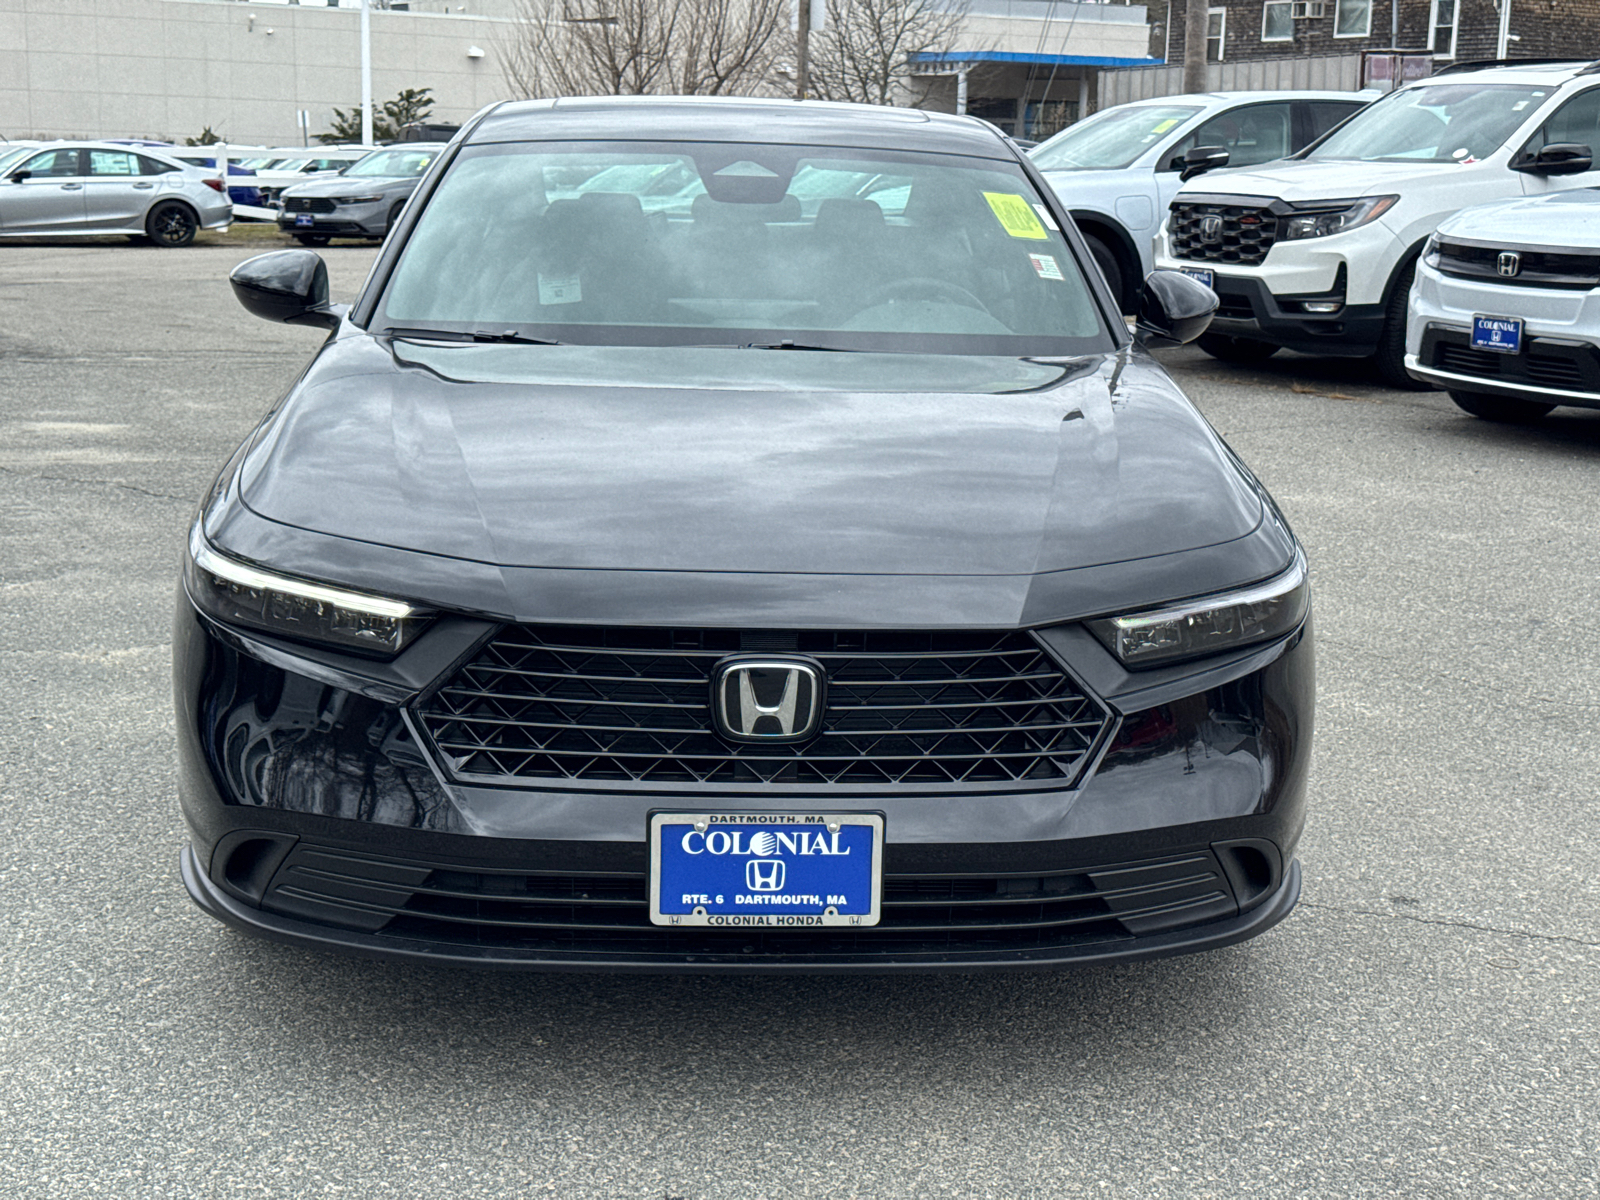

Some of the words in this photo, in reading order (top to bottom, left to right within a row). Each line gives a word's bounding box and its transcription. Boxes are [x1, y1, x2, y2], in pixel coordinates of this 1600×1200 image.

[804, 816, 825, 824] MA
[681, 831, 851, 857] COLONIAL
[682, 894, 713, 905] RTE.
[715, 894, 725, 905] 6
[735, 894, 824, 907] DARTMOUTH,
[826, 895, 848, 905] MA
[707, 915, 773, 926] COLONIAL
[776, 916, 824, 926] HONDA
